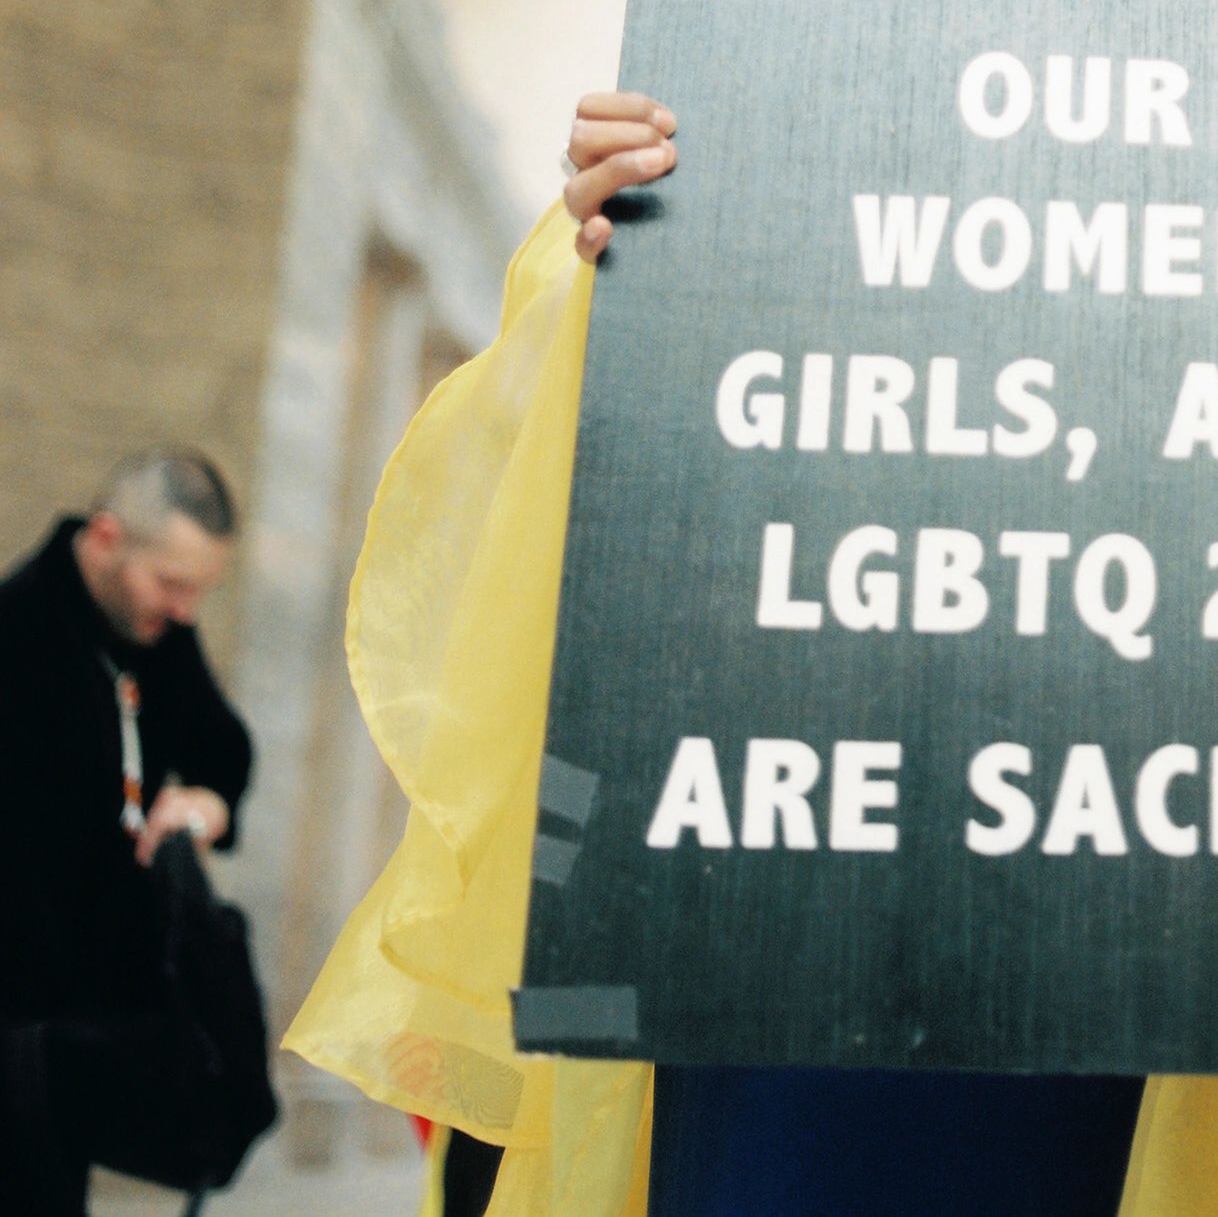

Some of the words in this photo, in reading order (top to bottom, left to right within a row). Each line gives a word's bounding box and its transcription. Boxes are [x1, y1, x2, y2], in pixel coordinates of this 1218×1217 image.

[957, 50, 1195, 149] OUR
[716, 351, 1098, 481] GIRLS,
[757, 524, 1156, 659] LGBTQ
[648, 737, 901, 850] ARE
